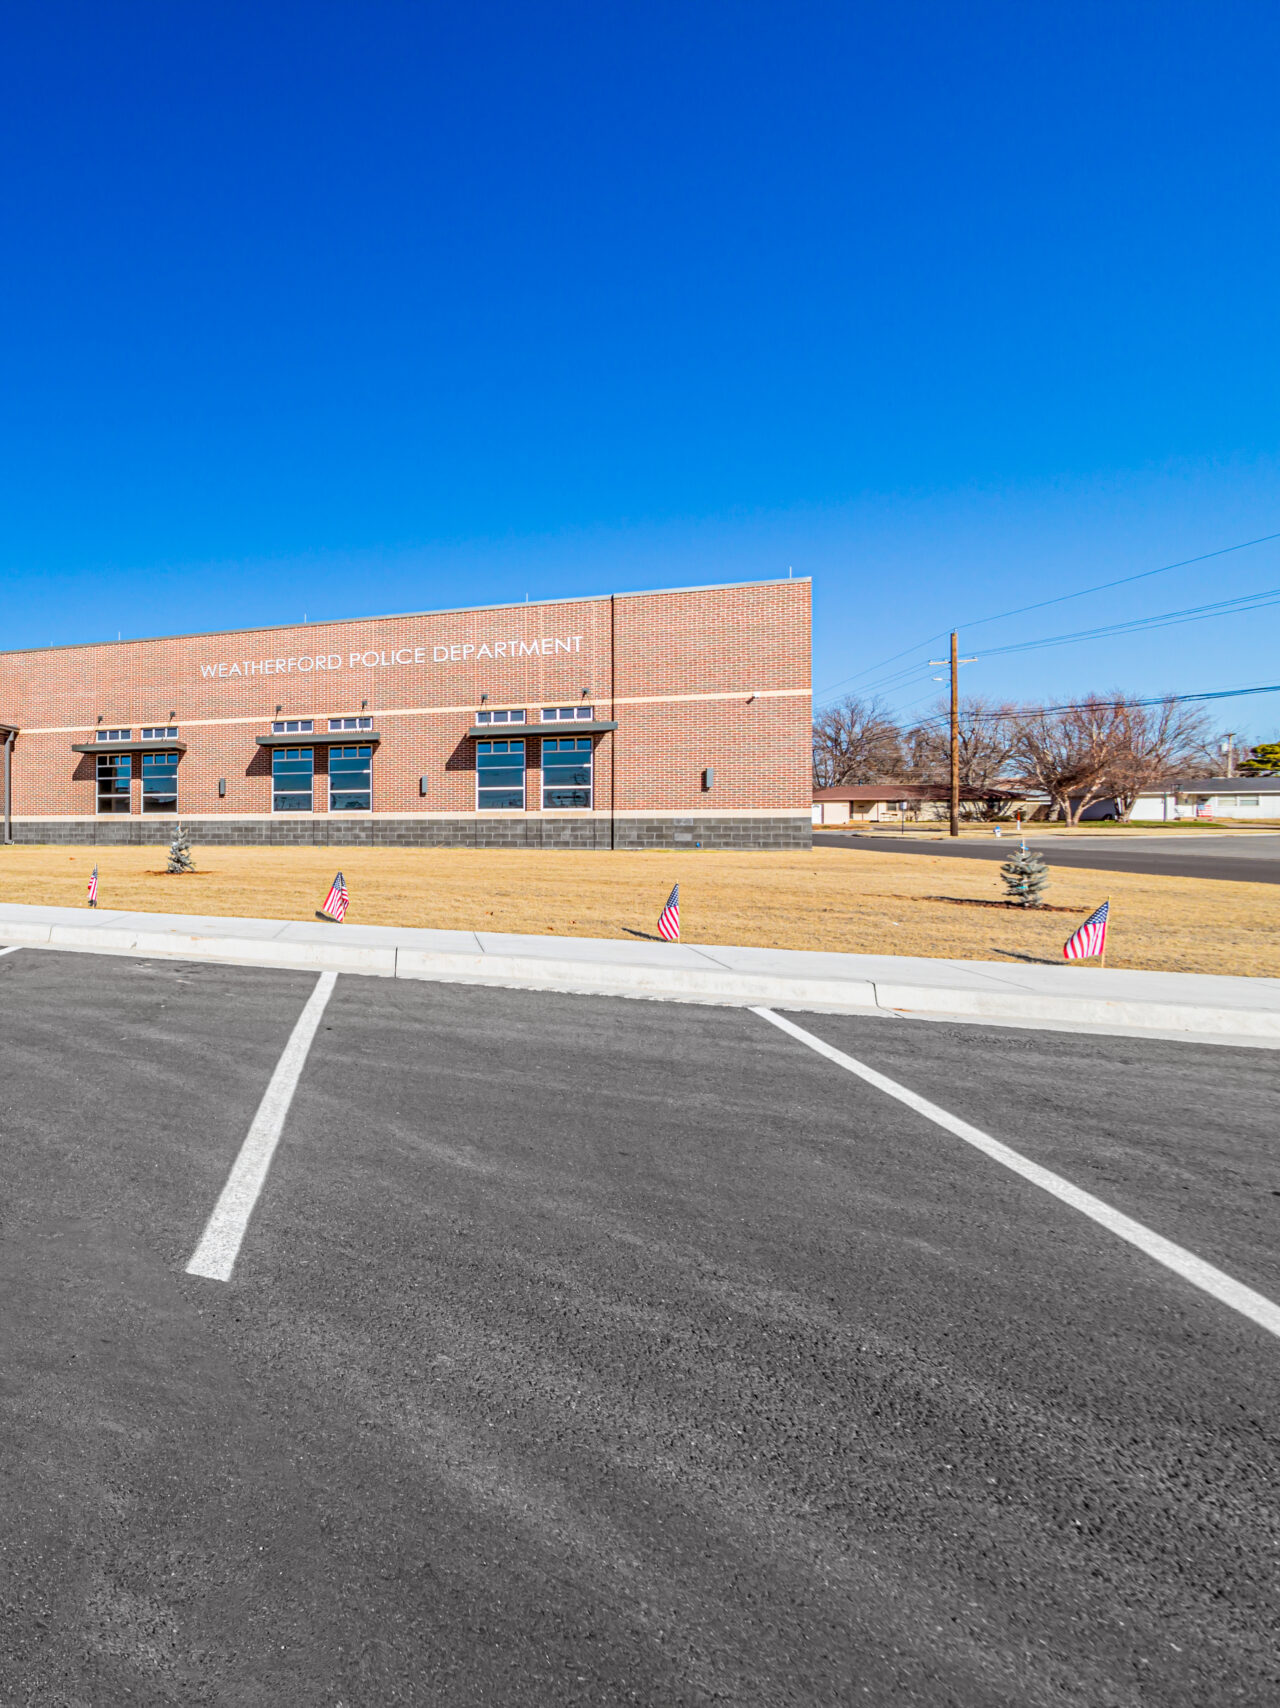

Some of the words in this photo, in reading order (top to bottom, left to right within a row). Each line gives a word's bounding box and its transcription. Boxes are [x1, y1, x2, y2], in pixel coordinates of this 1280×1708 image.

[200, 654, 342, 678] WEATHERFORD
[349, 647, 426, 668] POLICE
[433, 636, 584, 662] DEPARTMENT
